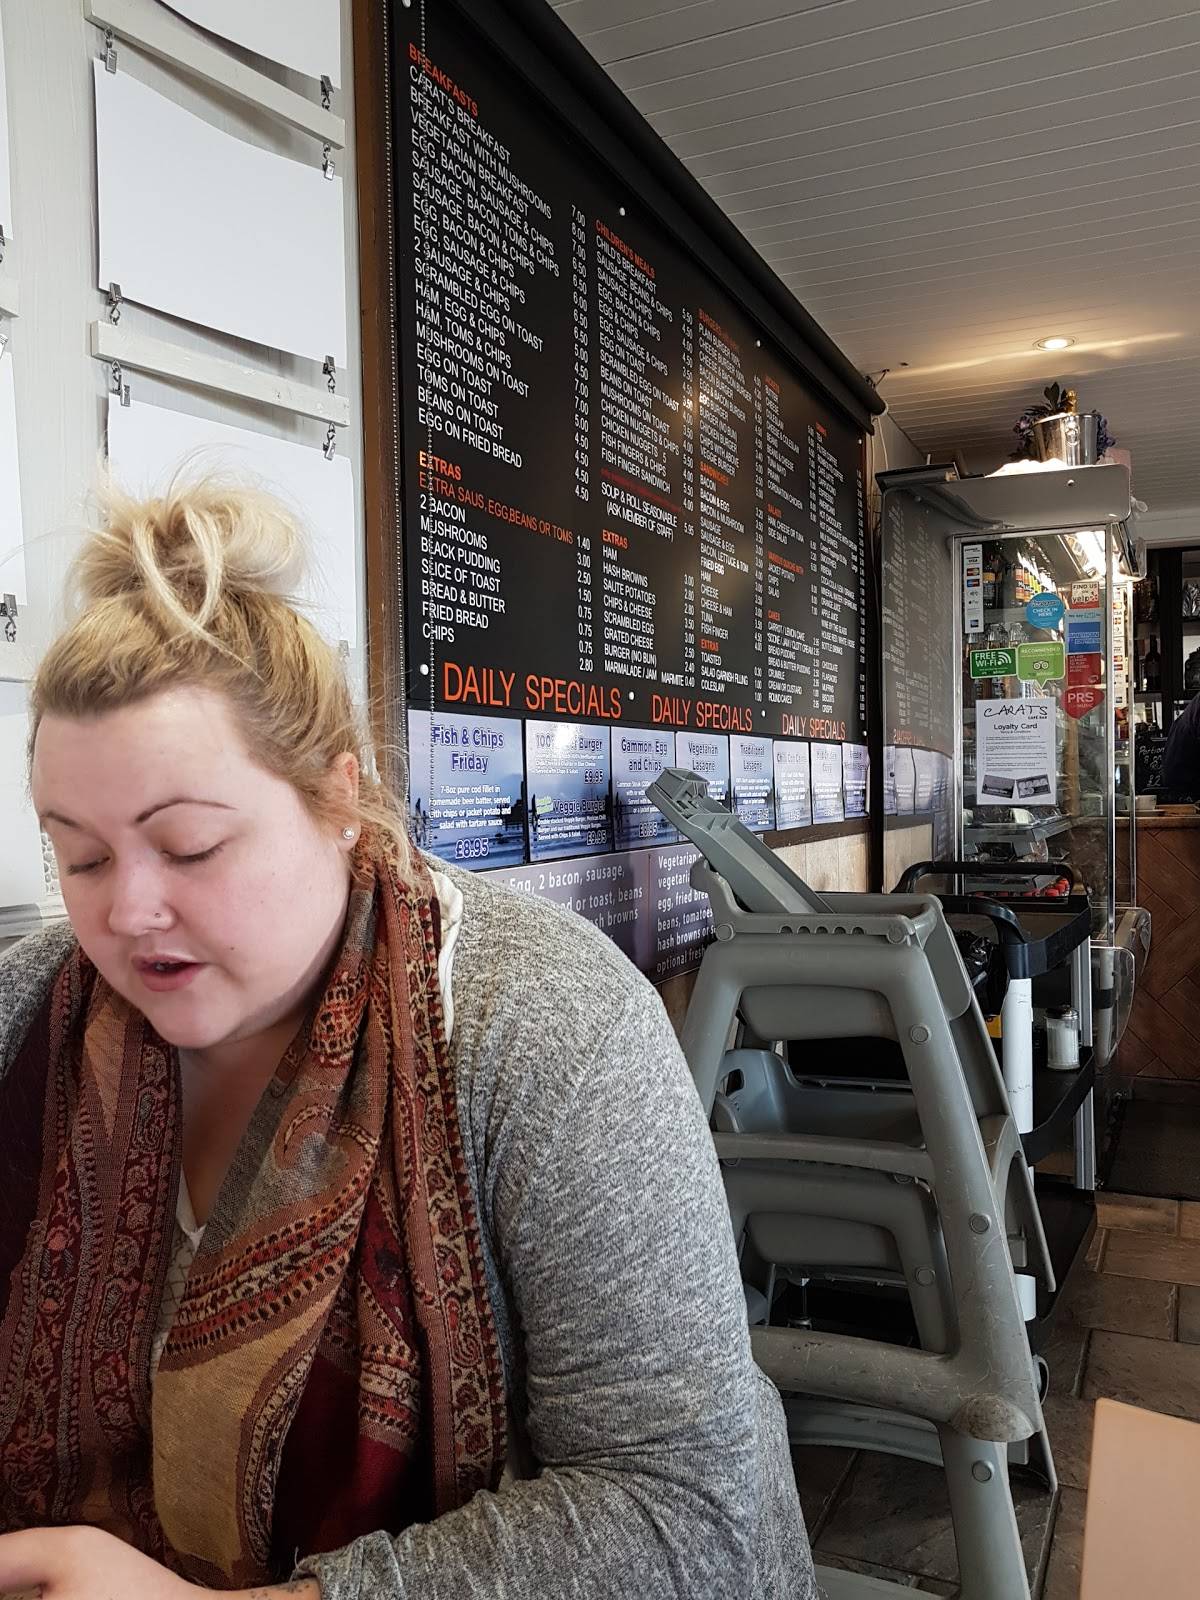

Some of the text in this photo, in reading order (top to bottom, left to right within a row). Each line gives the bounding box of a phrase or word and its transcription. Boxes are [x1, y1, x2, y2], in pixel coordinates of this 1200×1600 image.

[409, 42, 477, 117] BREAKFASTS
[456, 105, 510, 166] BREAKFAST
[410, 85, 551, 220] BREAKFAST WITH MUSHROOMS
[411, 106, 528, 217] VEGETARIAN BREAKFAST
[480, 184, 521, 230] SAUSAGE
[523, 219, 528, 236] &
[530, 226, 554, 257] CHIPS
[468, 212, 499, 249] BACON
[502, 238, 507, 256] &
[509, 245, 534, 275] CHIPS
[504, 222, 526, 252] TOMS
[529, 242, 534, 258] &
[536, 248, 559, 278] CHIPS
[414, 234, 420, 252] 2
[474, 276, 480, 293] &
[483, 281, 509, 313] CHIPS
[623, 255, 656, 296] BREAKFAST
[634, 251, 655, 280] MEALS
[444, 296, 466, 323] EGG
[469, 311, 475, 328] &
[478, 317, 504, 347] CHIPS
[480, 299, 499, 325] EGG
[502, 314, 514, 334] ON
[516, 323, 543, 353] TOAST
[416, 320, 529, 399] MUSHROOMS ON TOAST
[417, 342, 492, 396] EGG ON TOAST
[418, 385, 503, 441] BEANS ON TOAST
[418, 407, 521, 469] EGG ON FRIED BREAD
[420, 493, 426, 509] 2
[577, 552, 590, 568] 3.00
[539, 520, 550, 536] OR
[552, 525, 573, 545] TOMS
[576, 534, 590, 551] 1.40
[602, 529, 627, 549] EXTRAS
[420, 515, 590, 586] MUSHROOMS 2.50
[602, 545, 617, 561] HAM
[458, 548, 500, 574] PUDDING
[577, 587, 591, 603] 1.50
[602, 561, 648, 587] HASH BROWNS
[454, 567, 467, 584] OF
[470, 572, 500, 593] TOAST
[578, 605, 591, 620] 0.75
[422, 579, 592, 637] BREAD & BUTTER 0.75
[603, 594, 652, 619] CHIPS & CHEESE
[422, 601, 592, 654] FRIED BREAD 0.75
[603, 610, 654, 634] SCRAMBLED EGG
[422, 622, 592, 672] CHIPS 2.80
[604, 627, 653, 649] GRATED CHEESE
[975, 652, 995, 660] FREE
[975, 659, 997, 667] WI-FI
[443, 662, 621, 718] DAILY SPECIALS
[1068, 692, 1094, 703] PRS
[652, 695, 752, 732] DAILY SPECIALS
[984, 704, 1048, 717] CARATS
[433, 726, 504, 750] Fish & Chips
[782, 714, 846, 740] DAILY SPECIALS
[579, 738, 602, 752] Burger
[655, 741, 667, 755] Egg
[688, 742, 718, 755] Vegetarian
[452, 753, 488, 773] Friday
[629, 759, 661, 774] and Chips
[692, 760, 715, 773] Lasagne
[458, 786, 469, 794] pure
[471, 785, 481, 793] cod
[462, 797, 474, 805] beer
[443, 809, 458, 818] chips
[466, 808, 482, 817] jacket
[484, 808, 500, 816] potato
[501, 807, 511, 815] and
[553, 800, 580, 815] Veggie
[581, 799, 605, 814] Burger
[440, 821, 454, 829] salad
[456, 838, 488, 859] £8.95
[659, 851, 696, 871] Vegetarian
[539, 875, 545, 890] 2
[659, 870, 690, 890] vegetari
[575, 898, 587, 911] or
[619, 886, 643, 903] beans
[676, 890, 692, 906] fried
[694, 888, 708, 900] brea
[608, 908, 638, 926] browns
[683, 908, 713, 924] tomatoes
[658, 926, 709, 951] hash browns or
[657, 950, 686, 974] optional
